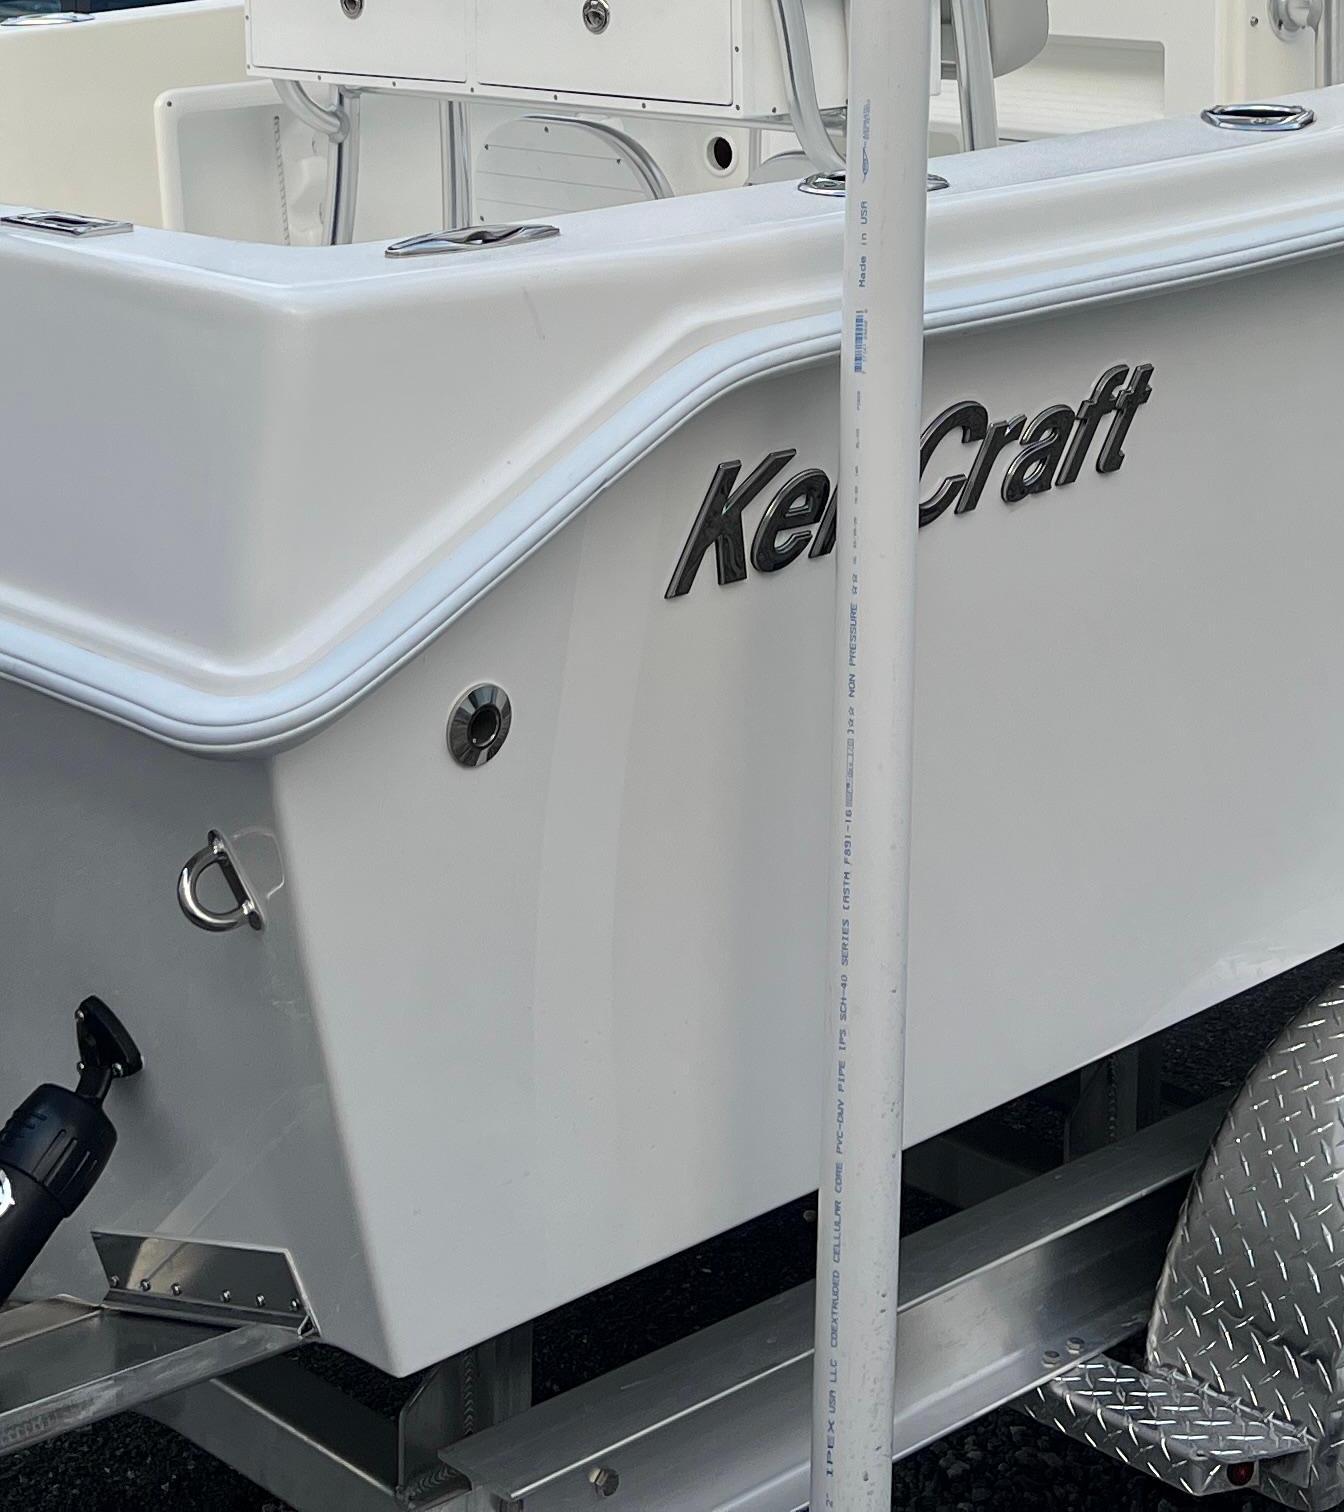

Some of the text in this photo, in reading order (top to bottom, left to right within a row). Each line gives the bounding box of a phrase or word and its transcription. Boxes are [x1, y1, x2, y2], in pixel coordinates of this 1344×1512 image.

[859, 200, 869, 288] Made in USA
[848, 602, 858, 698] NON PRESSURE
[841, 918, 851, 967] SERIES
[839, 974, 849, 1022] SCH-40
[839, 1029, 848, 1052] IPS
[838, 1060, 847, 1093] PIPE
[834, 1162, 844, 1194] CORE
[833, 1200, 843, 1264] CELLULAR
[830, 1270, 841, 1349] COEXTRUDED
[830, 1359, 838, 1383] LLC
[829, 1389, 838, 1414] USA
[825, 1420, 836, 1478] IPEX
